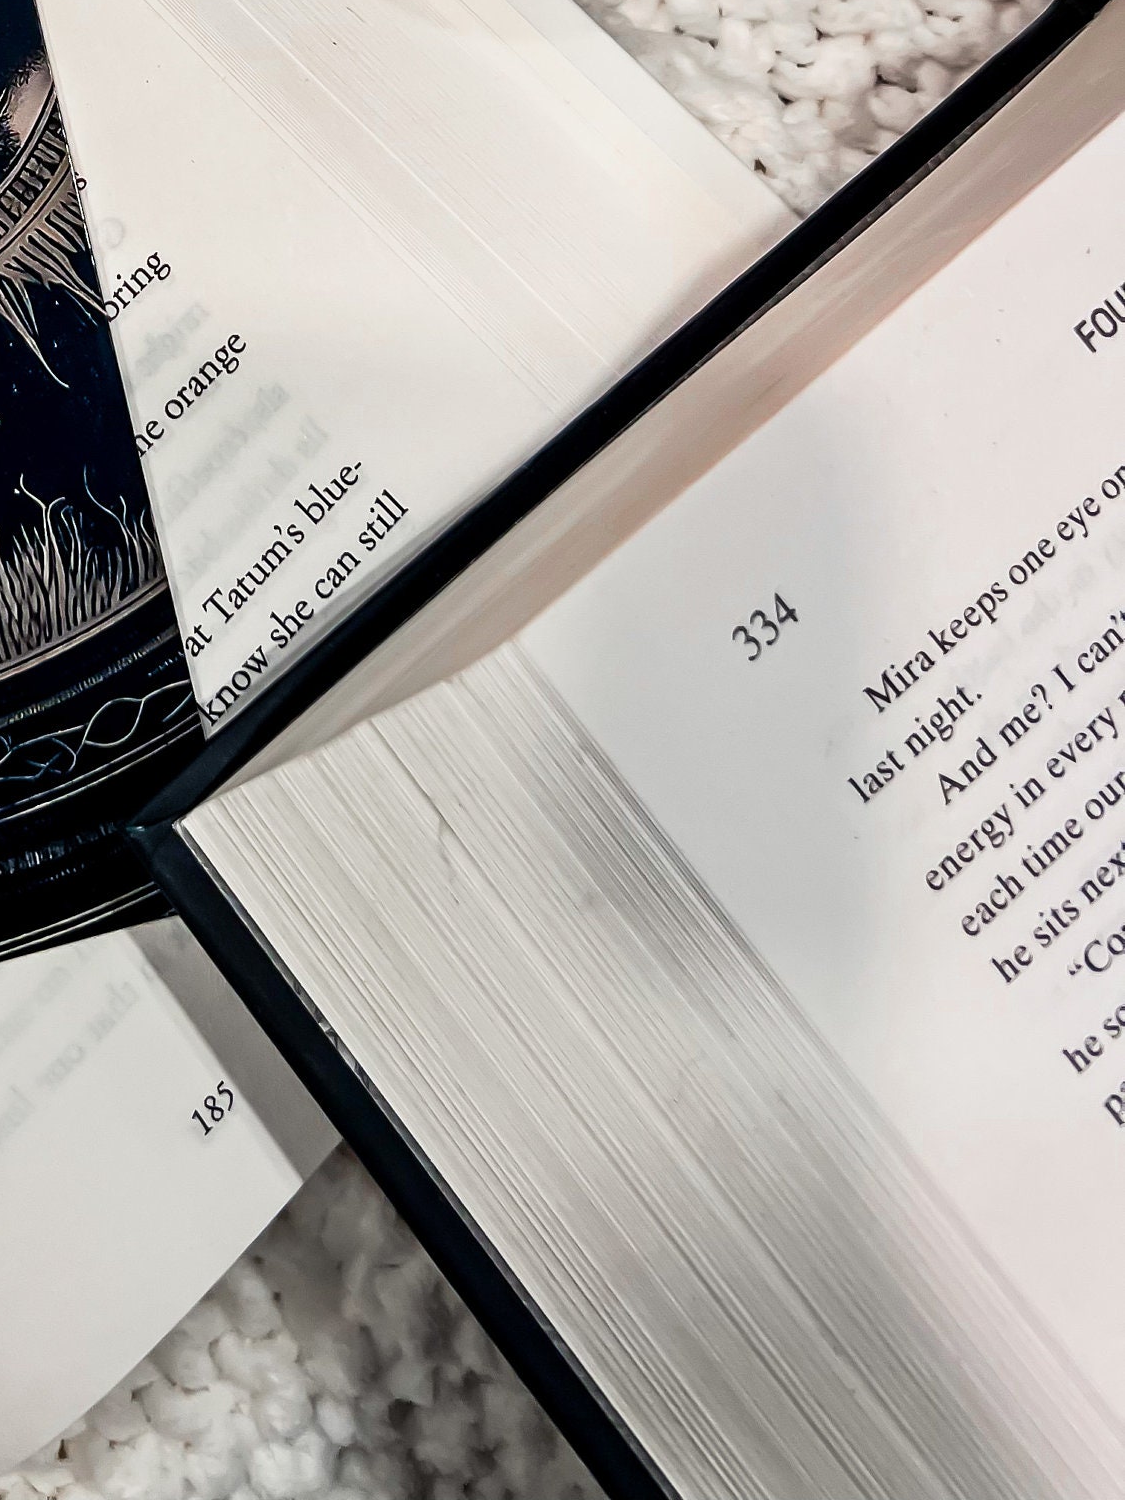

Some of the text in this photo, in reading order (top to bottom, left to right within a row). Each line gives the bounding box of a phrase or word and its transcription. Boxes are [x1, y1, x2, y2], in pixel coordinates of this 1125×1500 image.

[164, 334, 247, 420] orange
[293, 461, 362, 525] blue-
[197, 489, 409, 727] know she can still
[732, 592, 799, 662] 334
[862, 497, 1101, 713] Mira keeps one eye
[847, 686, 982, 804] last night.
[938, 664, 1076, 806] And me? I
[925, 707, 1119, 891] energy in every
[962, 818, 1084, 937] each time
[991, 899, 1080, 983] he sits
[191, 1079, 234, 1136] 185
